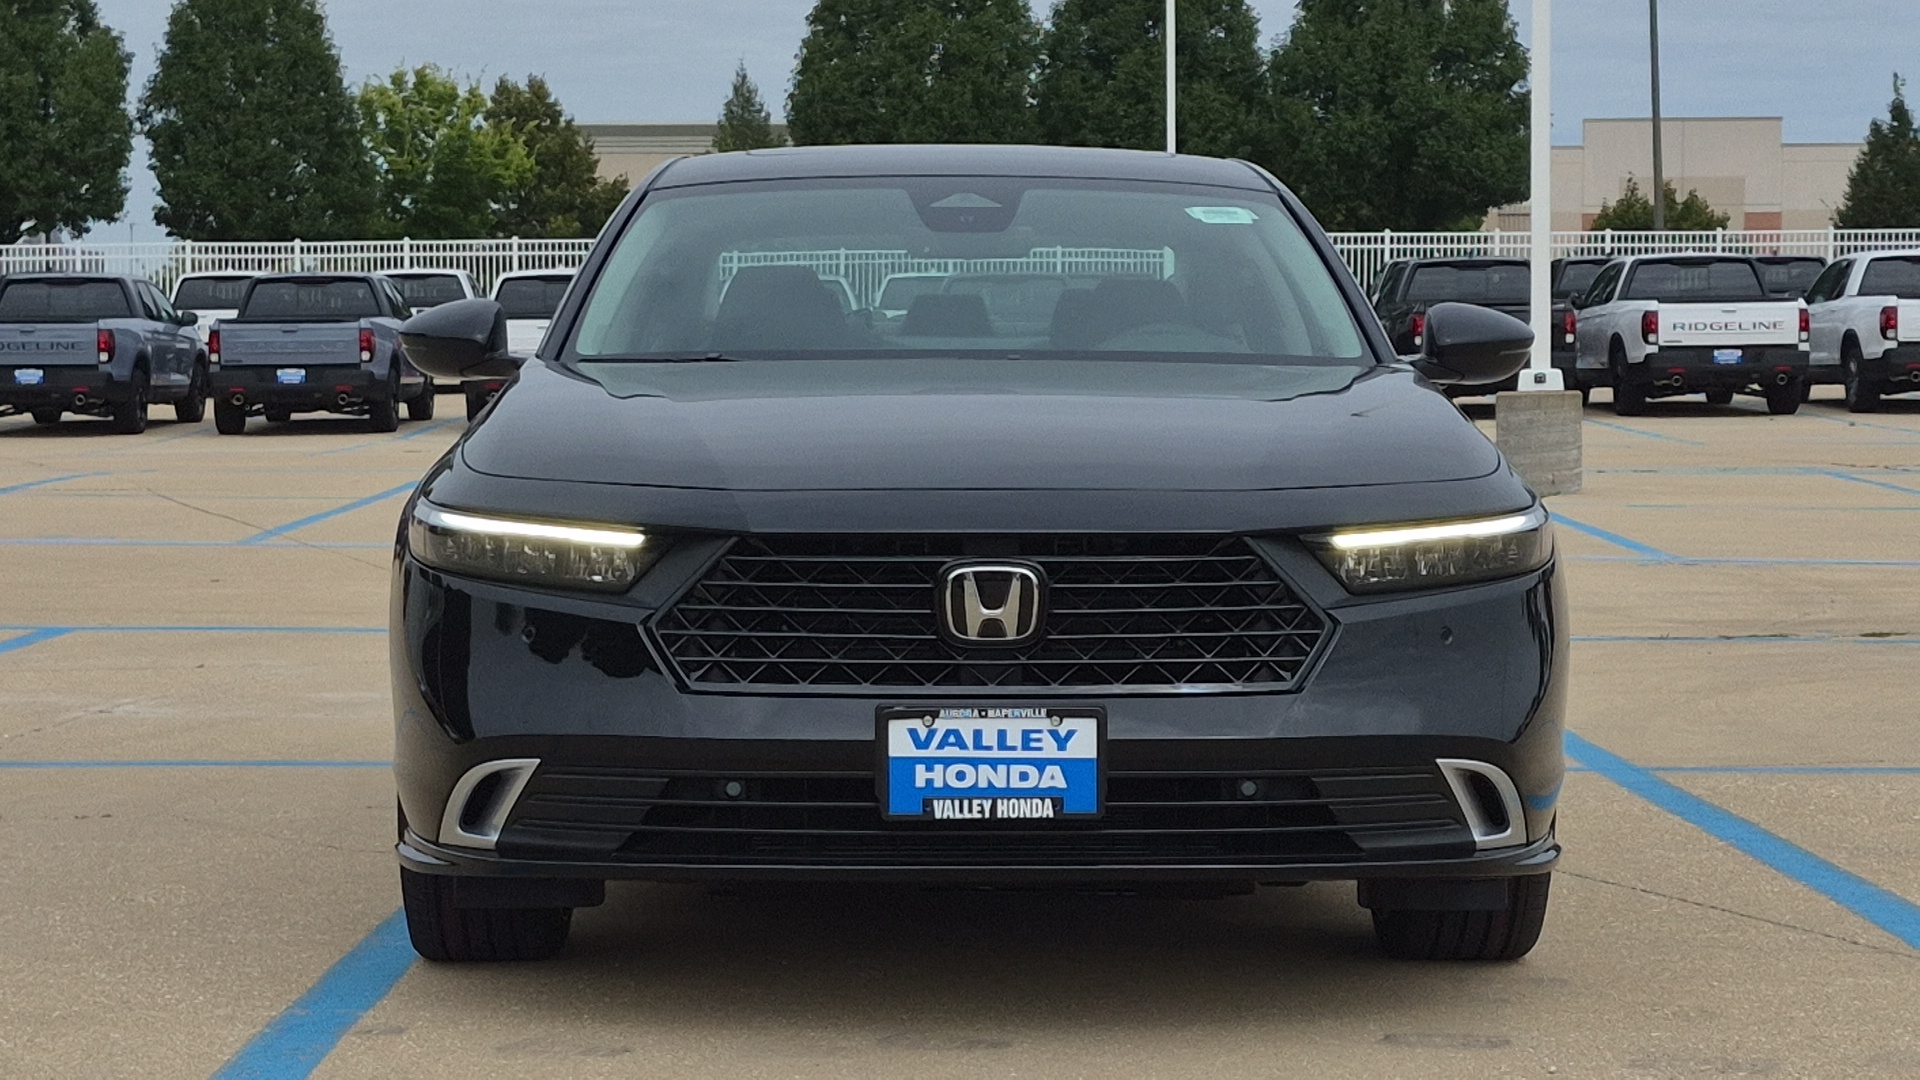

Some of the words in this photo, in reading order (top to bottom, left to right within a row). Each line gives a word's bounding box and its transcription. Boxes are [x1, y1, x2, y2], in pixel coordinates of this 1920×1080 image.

[1672, 321, 1785, 332] RIDGELINE
[906, 727, 1078, 752] VALLEY
[915, 763, 1068, 789] HONDA
[933, 798, 993, 820] VALLEY
[996, 798, 1055, 819] HONDA
